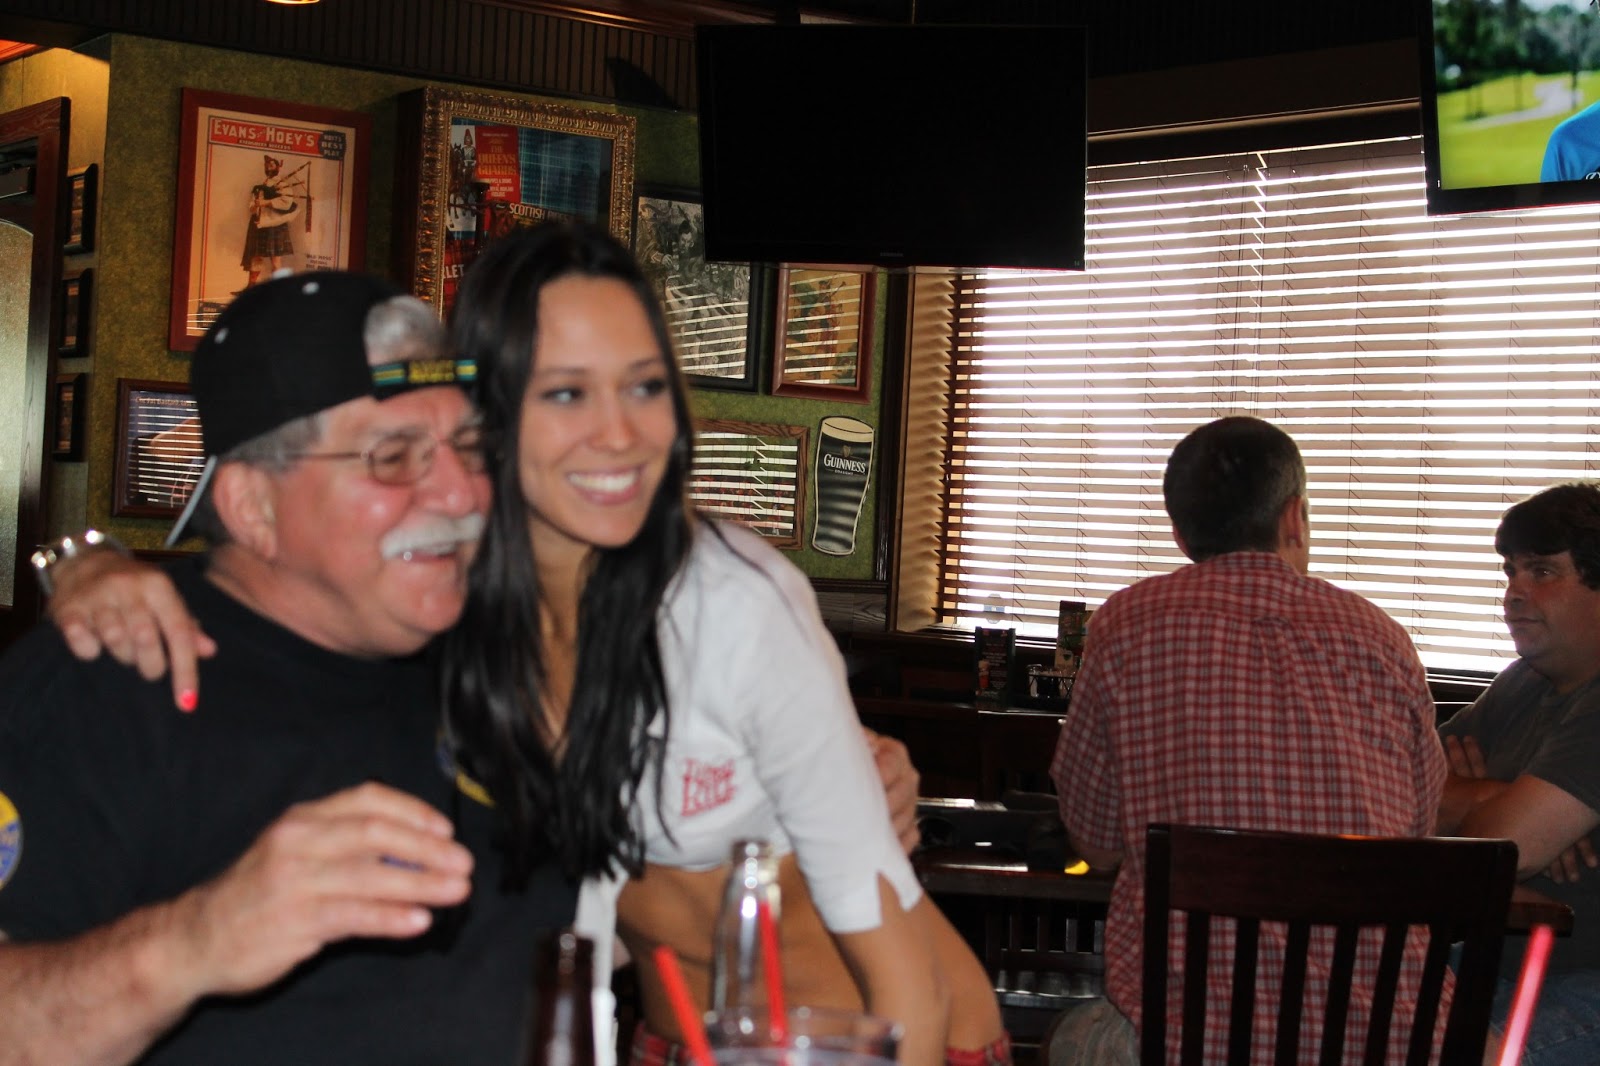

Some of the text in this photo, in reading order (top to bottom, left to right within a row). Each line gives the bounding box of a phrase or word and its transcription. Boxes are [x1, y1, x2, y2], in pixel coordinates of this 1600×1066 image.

[213, 118, 257, 140] EVANS
[265, 126, 316, 148] HOEY'S
[321, 141, 343, 150] BEST
[508, 202, 546, 220] SCOTTISH
[823, 452, 866, 474] GUINNESS
